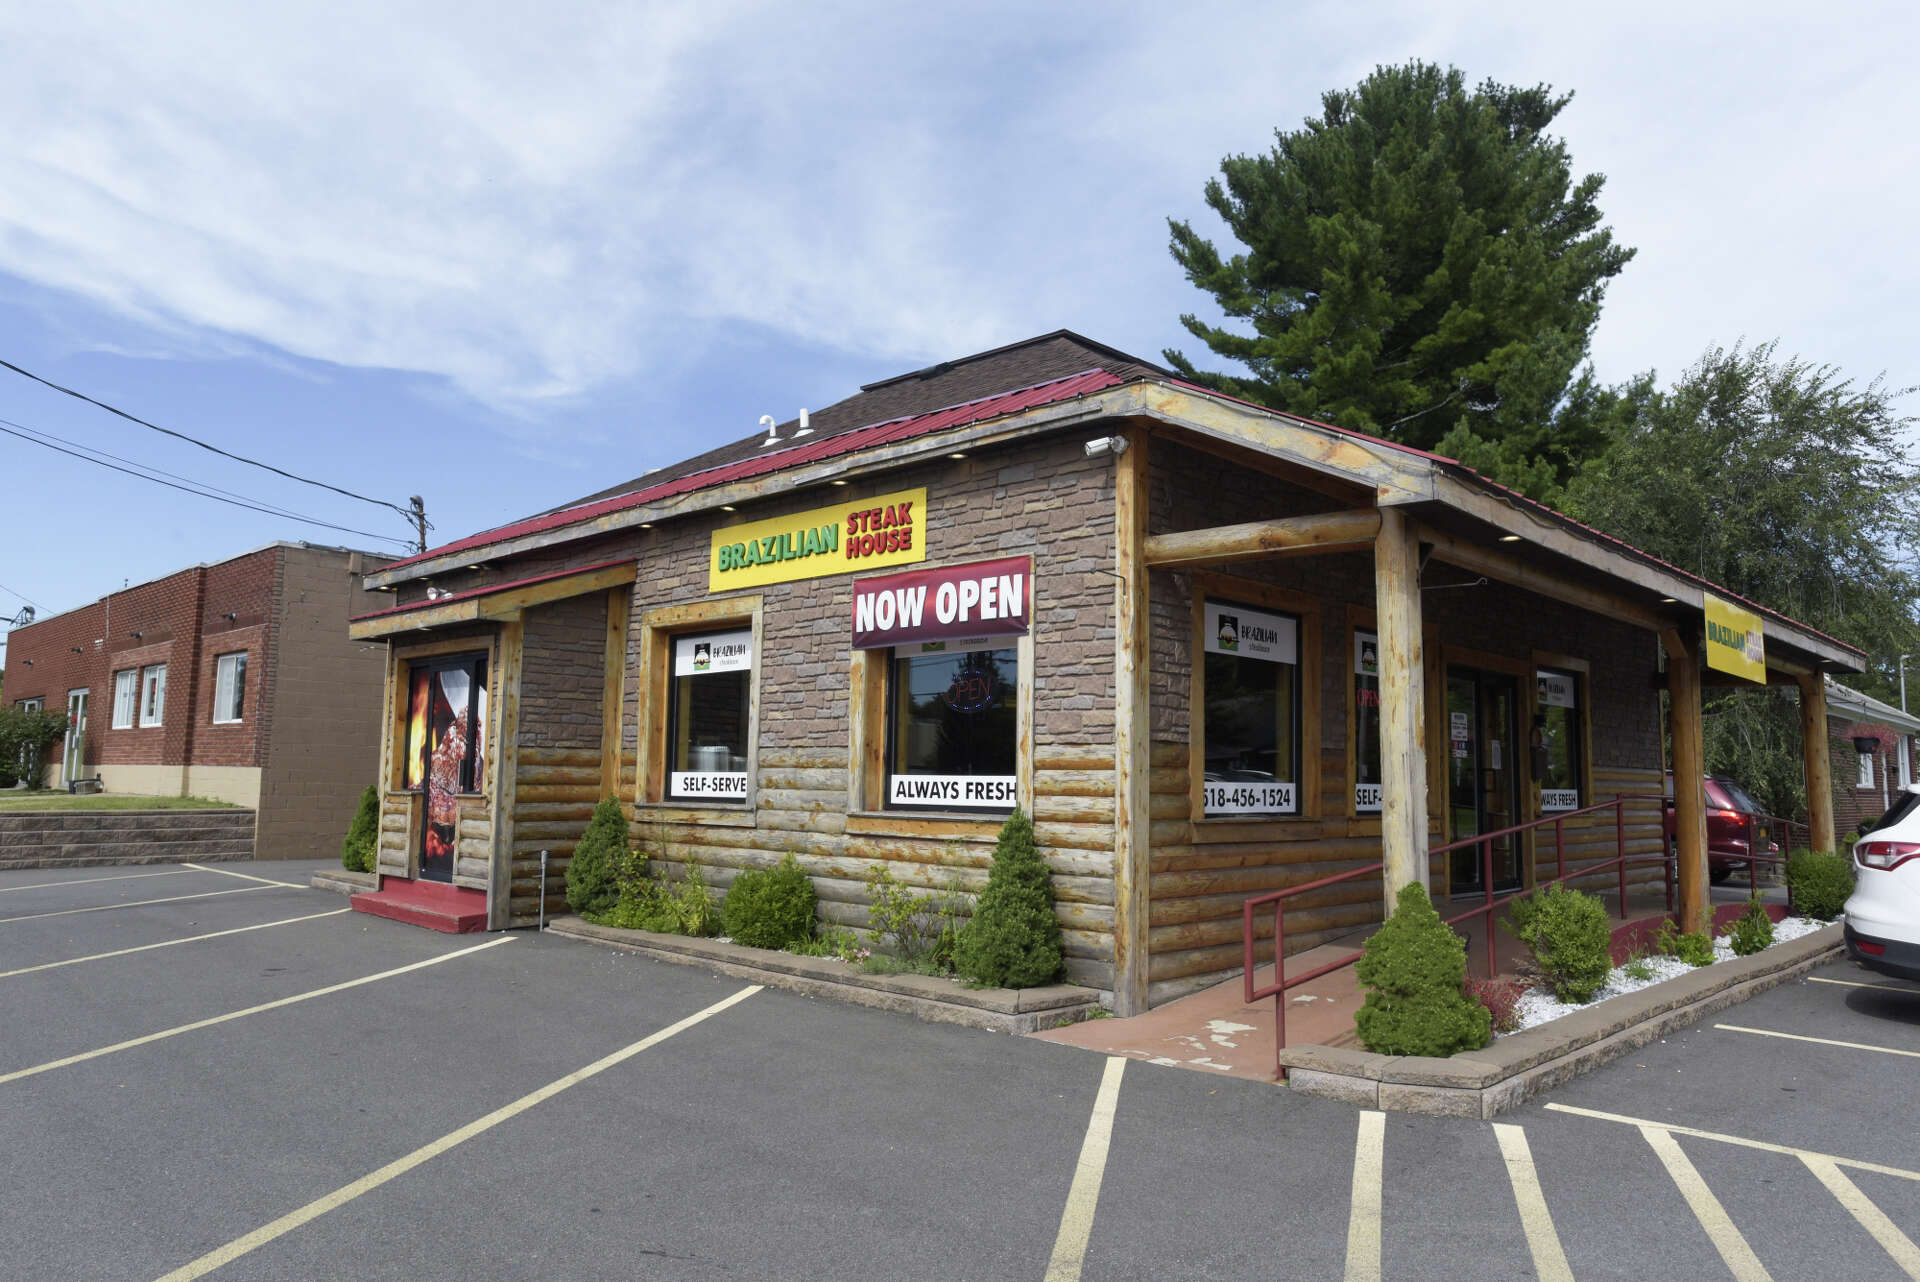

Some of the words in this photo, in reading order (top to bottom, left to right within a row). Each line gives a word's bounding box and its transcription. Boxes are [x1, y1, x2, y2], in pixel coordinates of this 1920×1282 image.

[846, 501, 913, 535] STEAK
[718, 523, 839, 572] BRAZILIAN
[846, 527, 913, 559] HOUSE
[855, 585, 928, 633] NOW
[935, 573, 1024, 625] OPEN
[1241, 624, 1278, 645] BRAZILIAN
[946, 676, 992, 704] OPEN
[683, 776, 747, 792] SELF-SERVE
[896, 781, 959, 800] ALWAYS
[965, 781, 1016, 801] FRESH
[1558, 792, 1576, 807] FRESH
